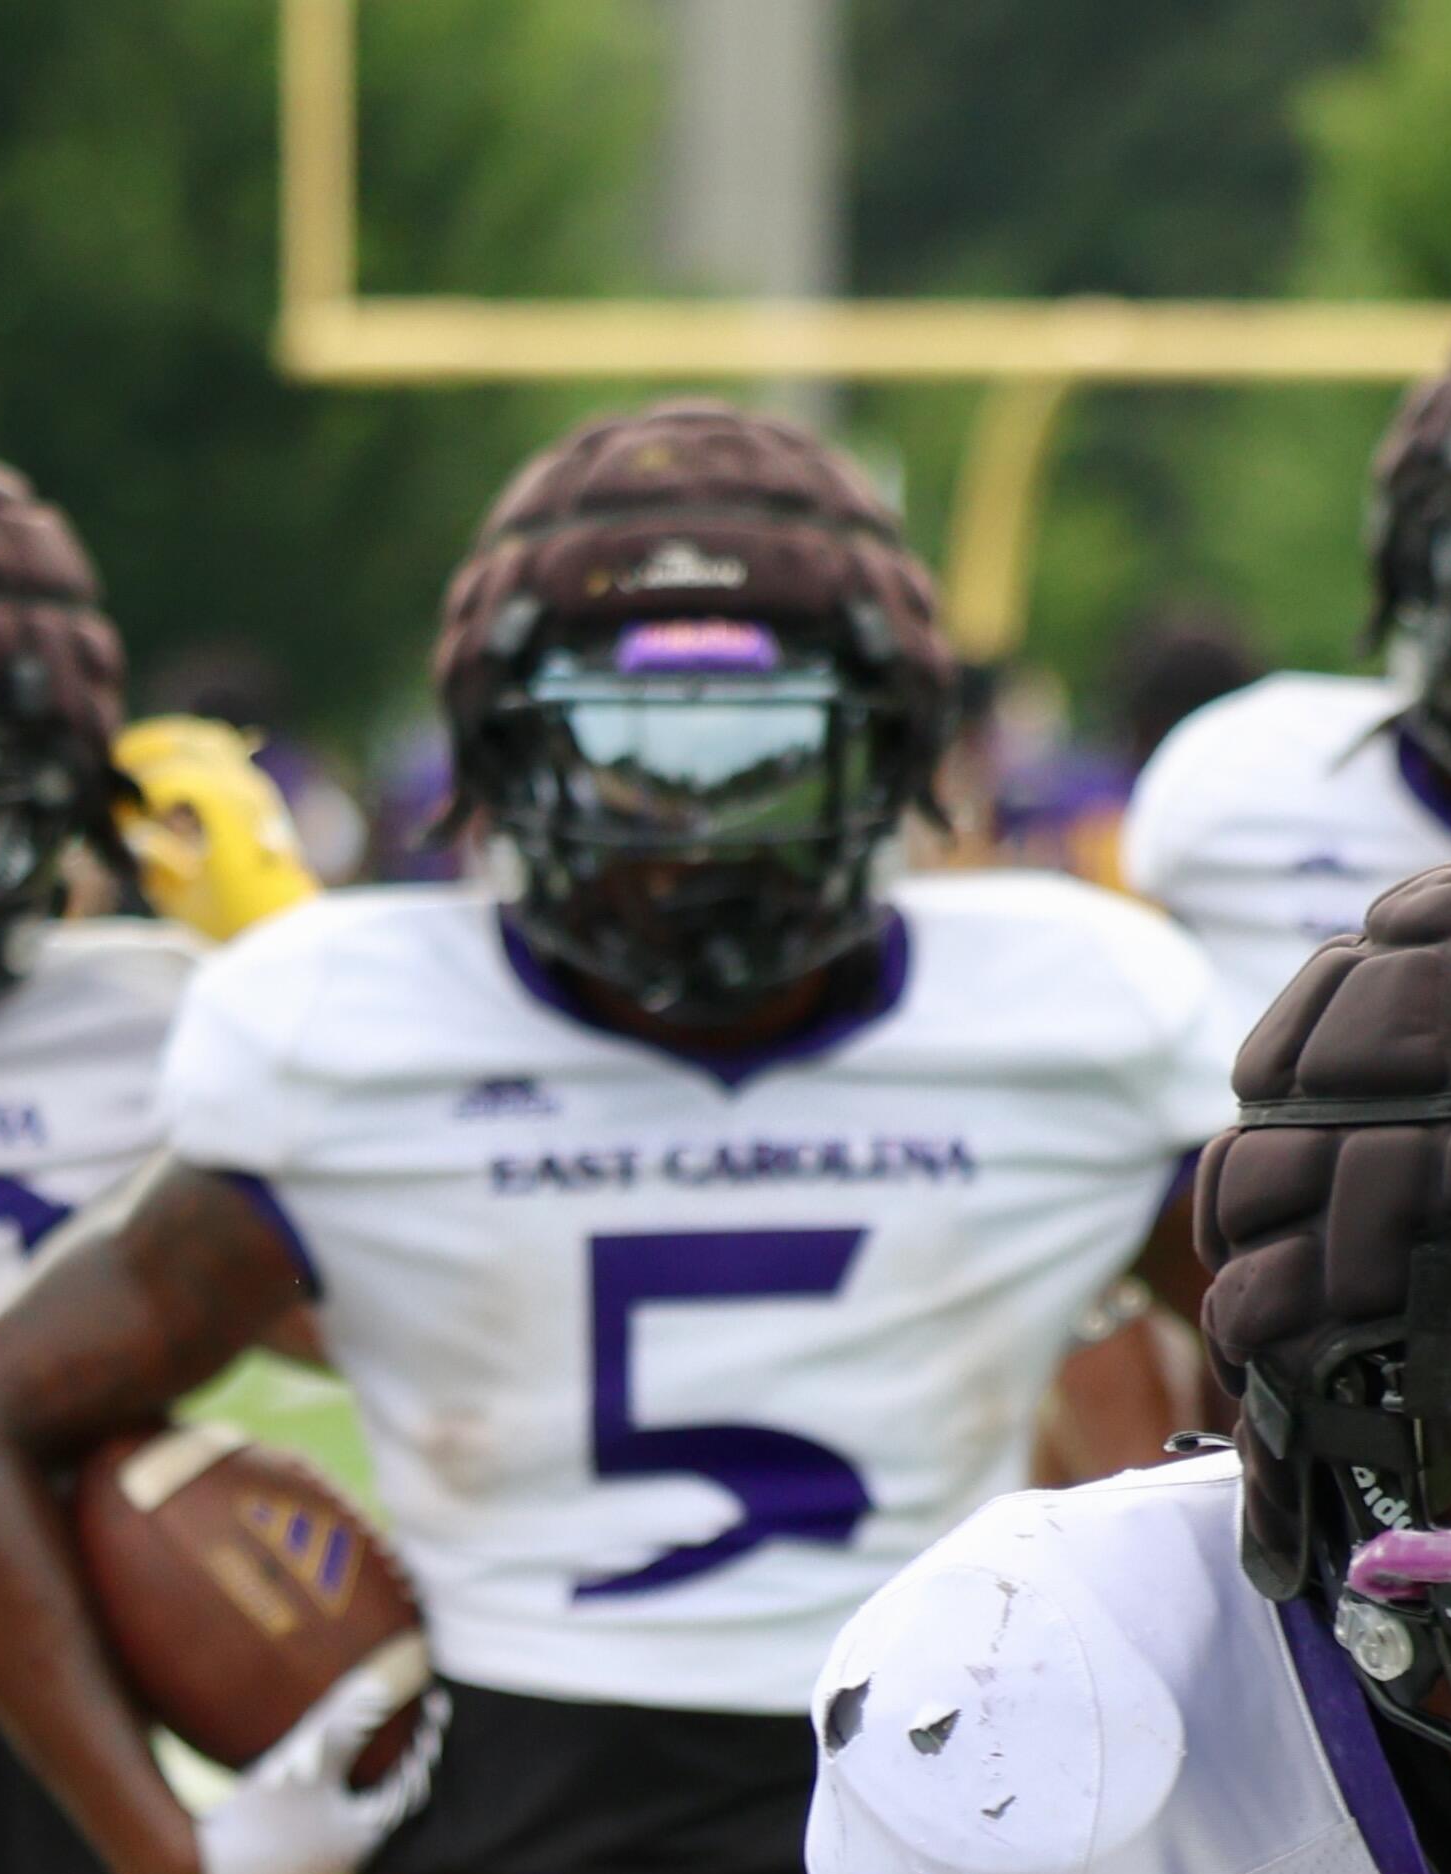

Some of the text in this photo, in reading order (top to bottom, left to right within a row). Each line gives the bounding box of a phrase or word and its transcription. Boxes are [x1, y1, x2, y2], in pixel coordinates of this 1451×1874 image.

[489, 1134, 977, 1193] EAST CAROLINA
[570, 1228, 874, 1603] 5
